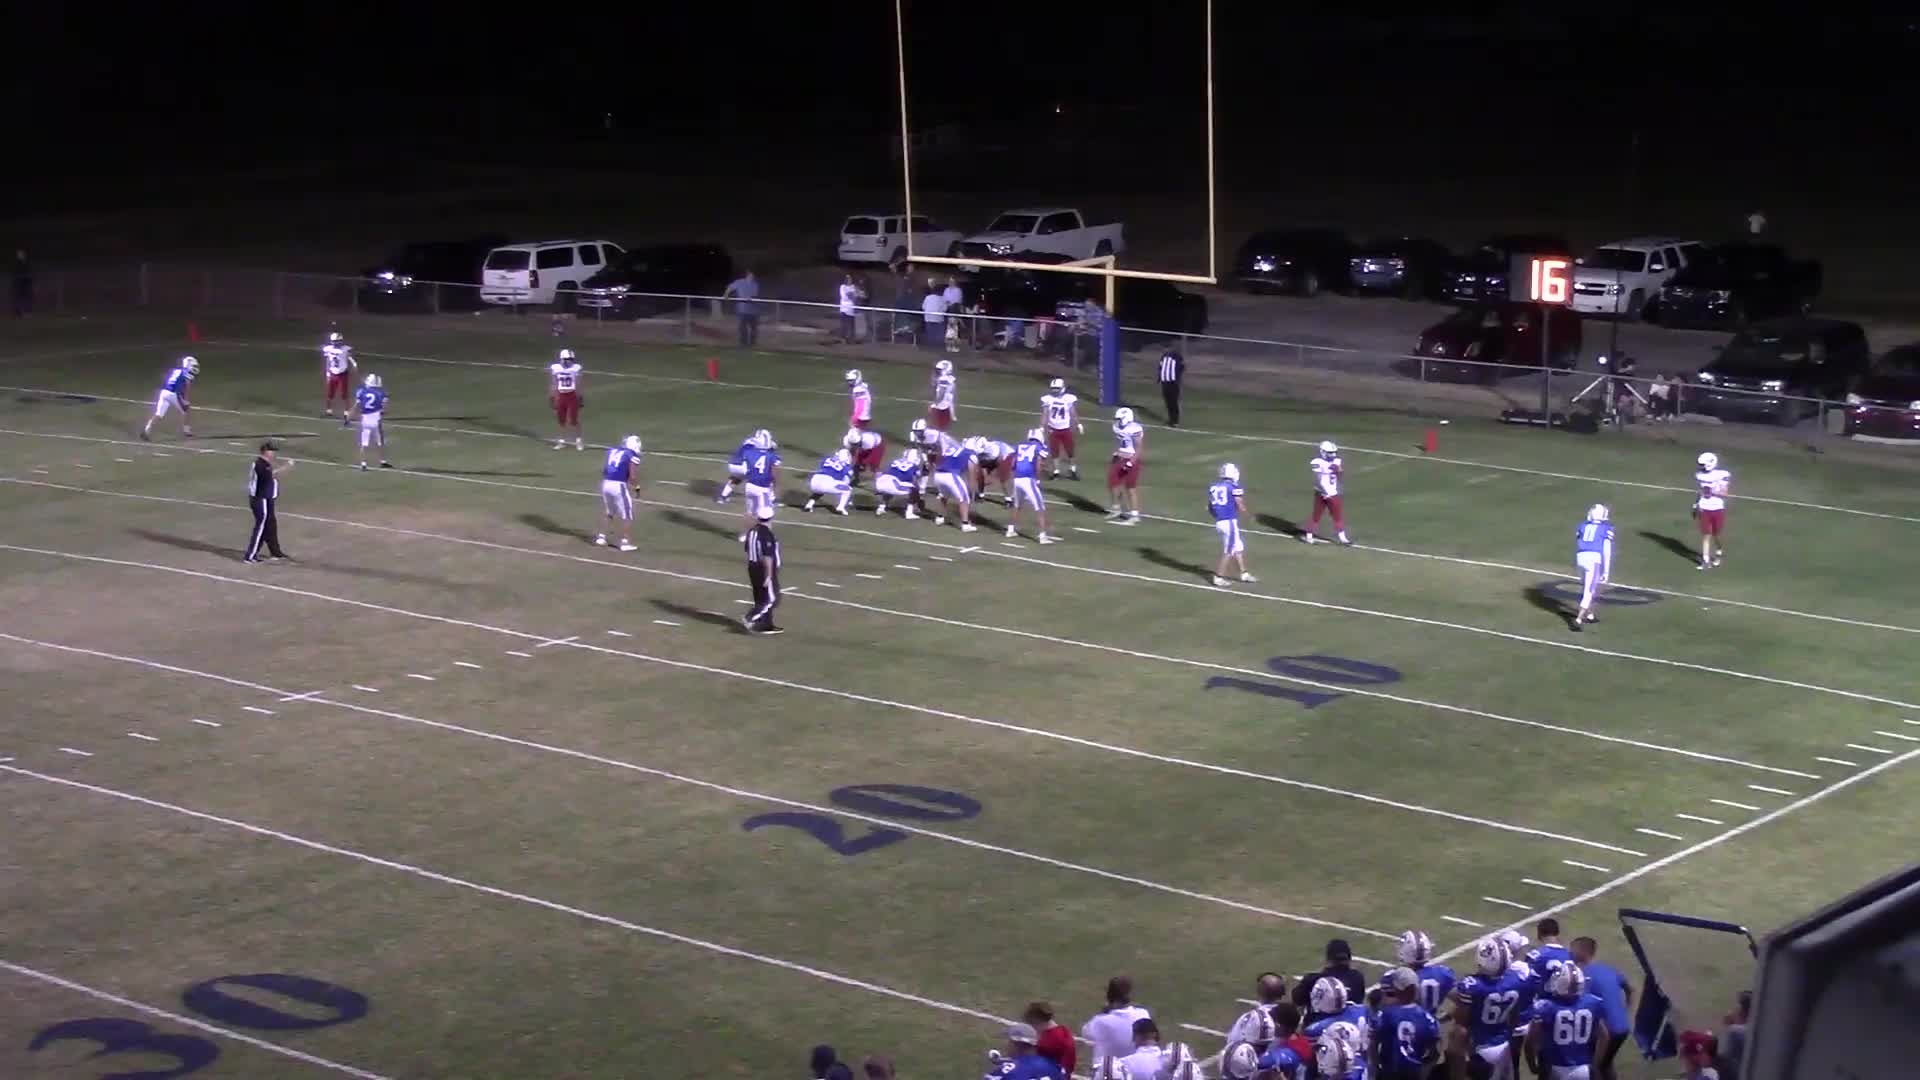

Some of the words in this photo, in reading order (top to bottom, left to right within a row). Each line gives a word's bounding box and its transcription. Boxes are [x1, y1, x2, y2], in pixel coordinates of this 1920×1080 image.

[1531, 259, 1567, 302] 16
[364, 393, 376, 409] 2
[1051, 406, 1066, 420] 74
[754, 455, 767, 474] 4
[1017, 444, 1037, 463] 54
[1204, 654, 1403, 710] 10
[741, 783, 983, 857] 20
[28, 972, 369, 1080] 30
[1553, 1009, 1593, 1046] 60
